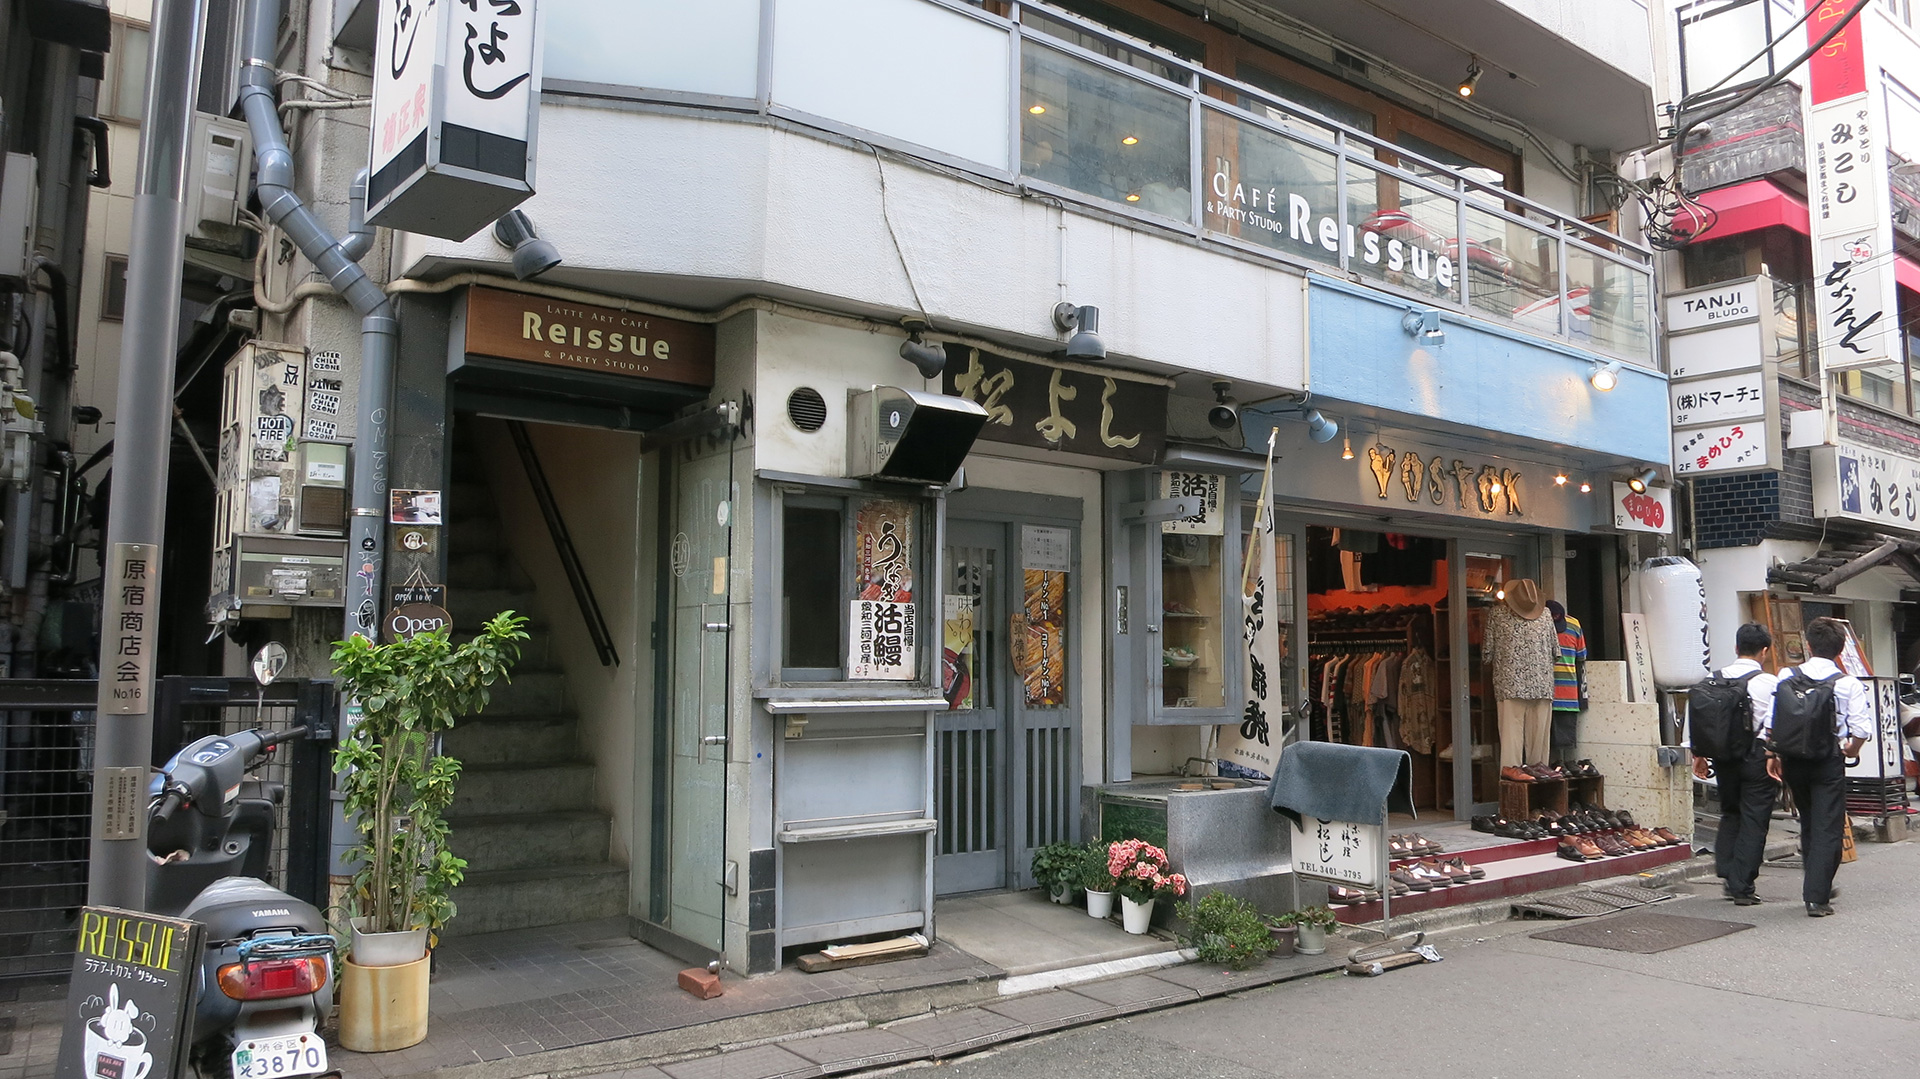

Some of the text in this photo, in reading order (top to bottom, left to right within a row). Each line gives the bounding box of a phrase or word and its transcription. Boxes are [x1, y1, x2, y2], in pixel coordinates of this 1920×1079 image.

[1856, 110, 1871, 163] やきとり
[1831, 123, 1857, 203] みこし
[1207, 201, 1213, 212] &
[1289, 193, 1453, 288] Reissue
[1684, 292, 1741, 313] TANJI
[1708, 306, 1749, 320] BLUDG
[522, 311, 670, 360] Reissue
[543, 350, 551, 358] &
[314, 363, 340, 371] OZONE
[1673, 368, 1685, 376] 4F
[954, 348, 1141, 449] 松よし
[1676, 387, 1760, 410] (株)ドマーチェ
[260, 418, 283, 429] HOT
[1677, 415, 1688, 423] 3F
[260, 429, 283, 441] FIRE
[1696, 426, 1744, 469] まめひろ
[1679, 463, 1691, 471] 2F
[1870, 477, 1917, 521] みこし
[1617, 515, 1624, 526] 2F
[117, 559, 146, 682] 原宿商店会
[392, 615, 443, 637] Open
[904, 604, 914, 652] 当店自慢の
[1316, 824, 1333, 863] 松よし
[1299, 861, 1318, 873] TEL
[252, 908, 290, 918] YAMAHA
[79, 912, 182, 973] REISSUE
[258, 1039, 297, 1054] 渋谷区
[255, 1047, 320, 1076] 3870
